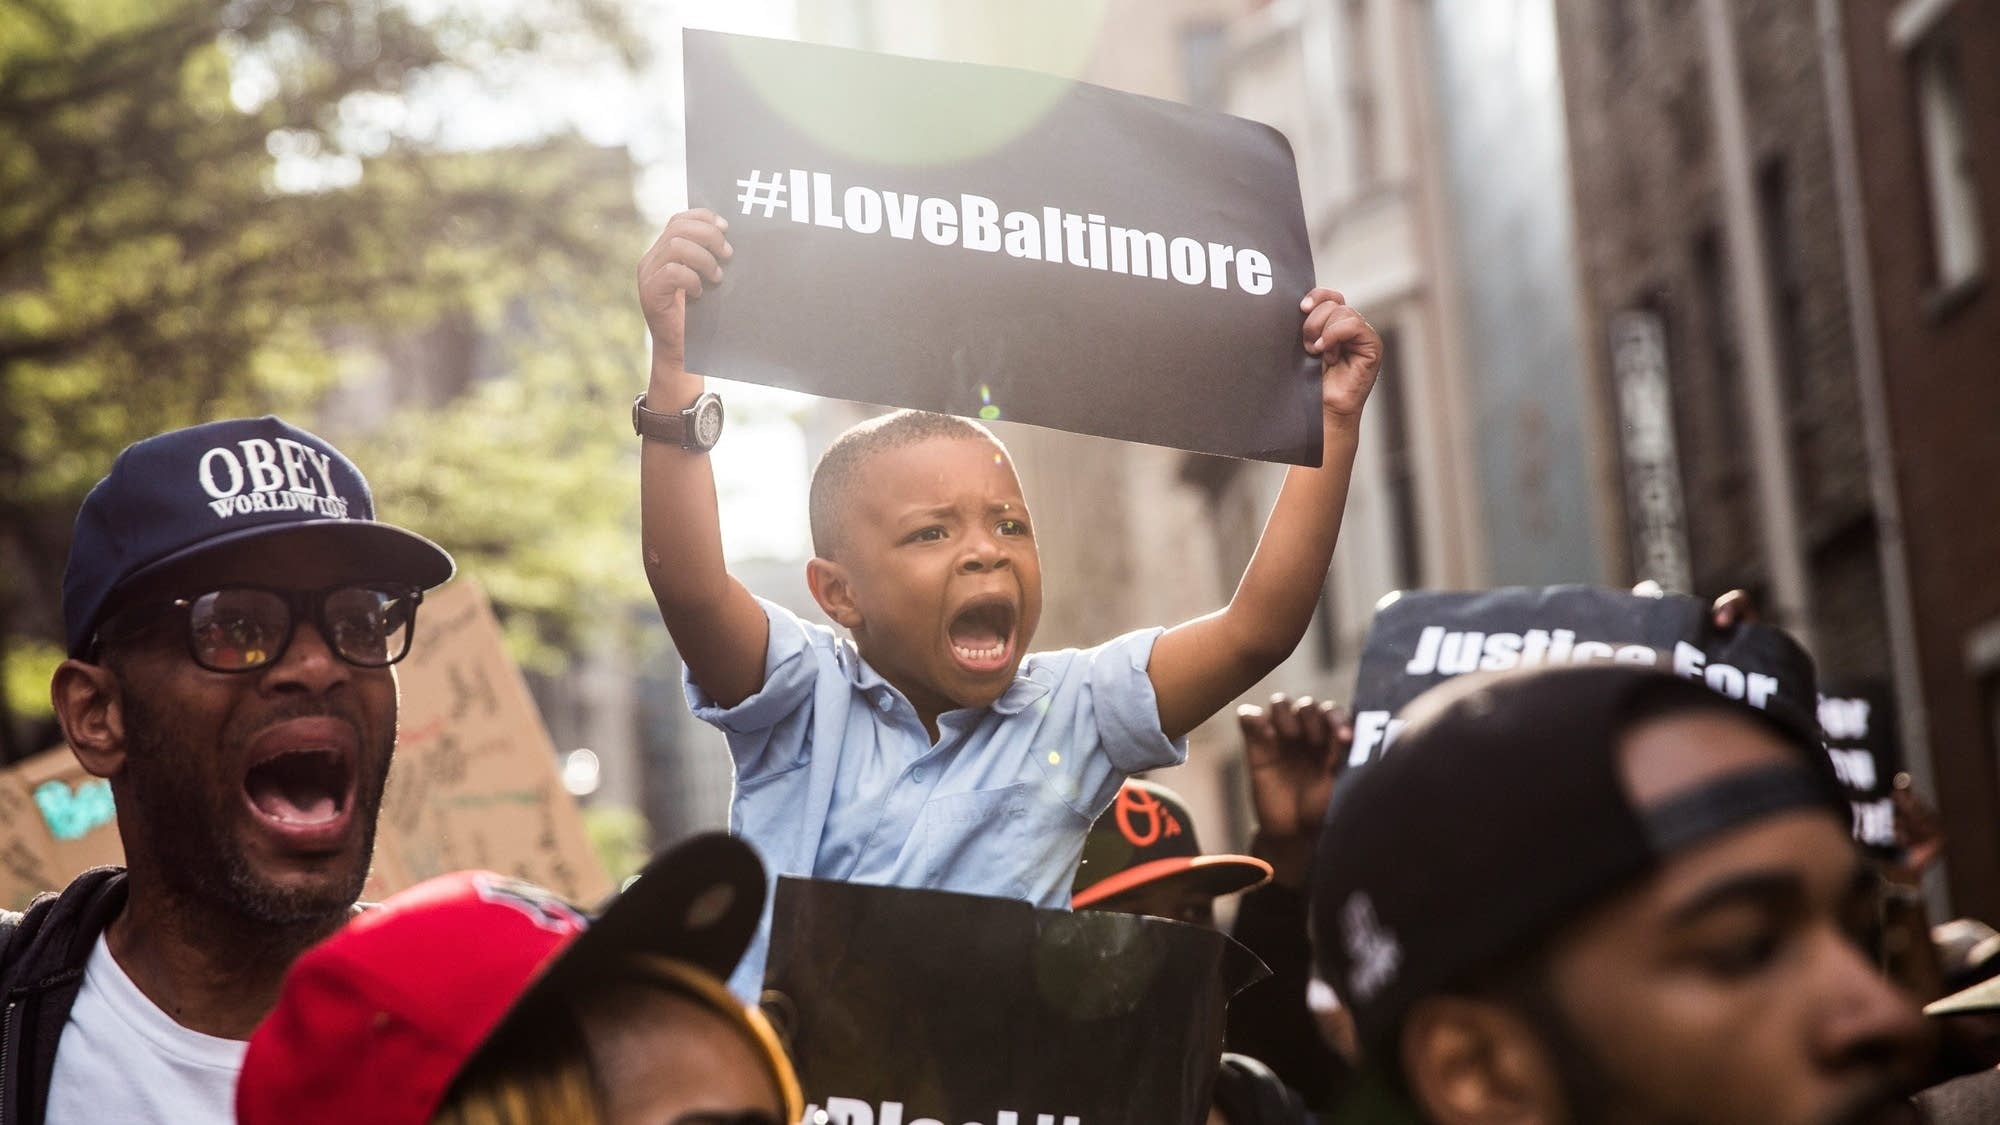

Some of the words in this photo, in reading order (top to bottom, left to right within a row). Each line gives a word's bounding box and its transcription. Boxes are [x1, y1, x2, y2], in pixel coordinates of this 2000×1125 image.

[736, 168, 1274, 296] #ILoveBaltimore
[198, 437, 337, 500] OBEY
[207, 490, 351, 522] WORLDWIDE
[1672, 640, 1780, 711] For
